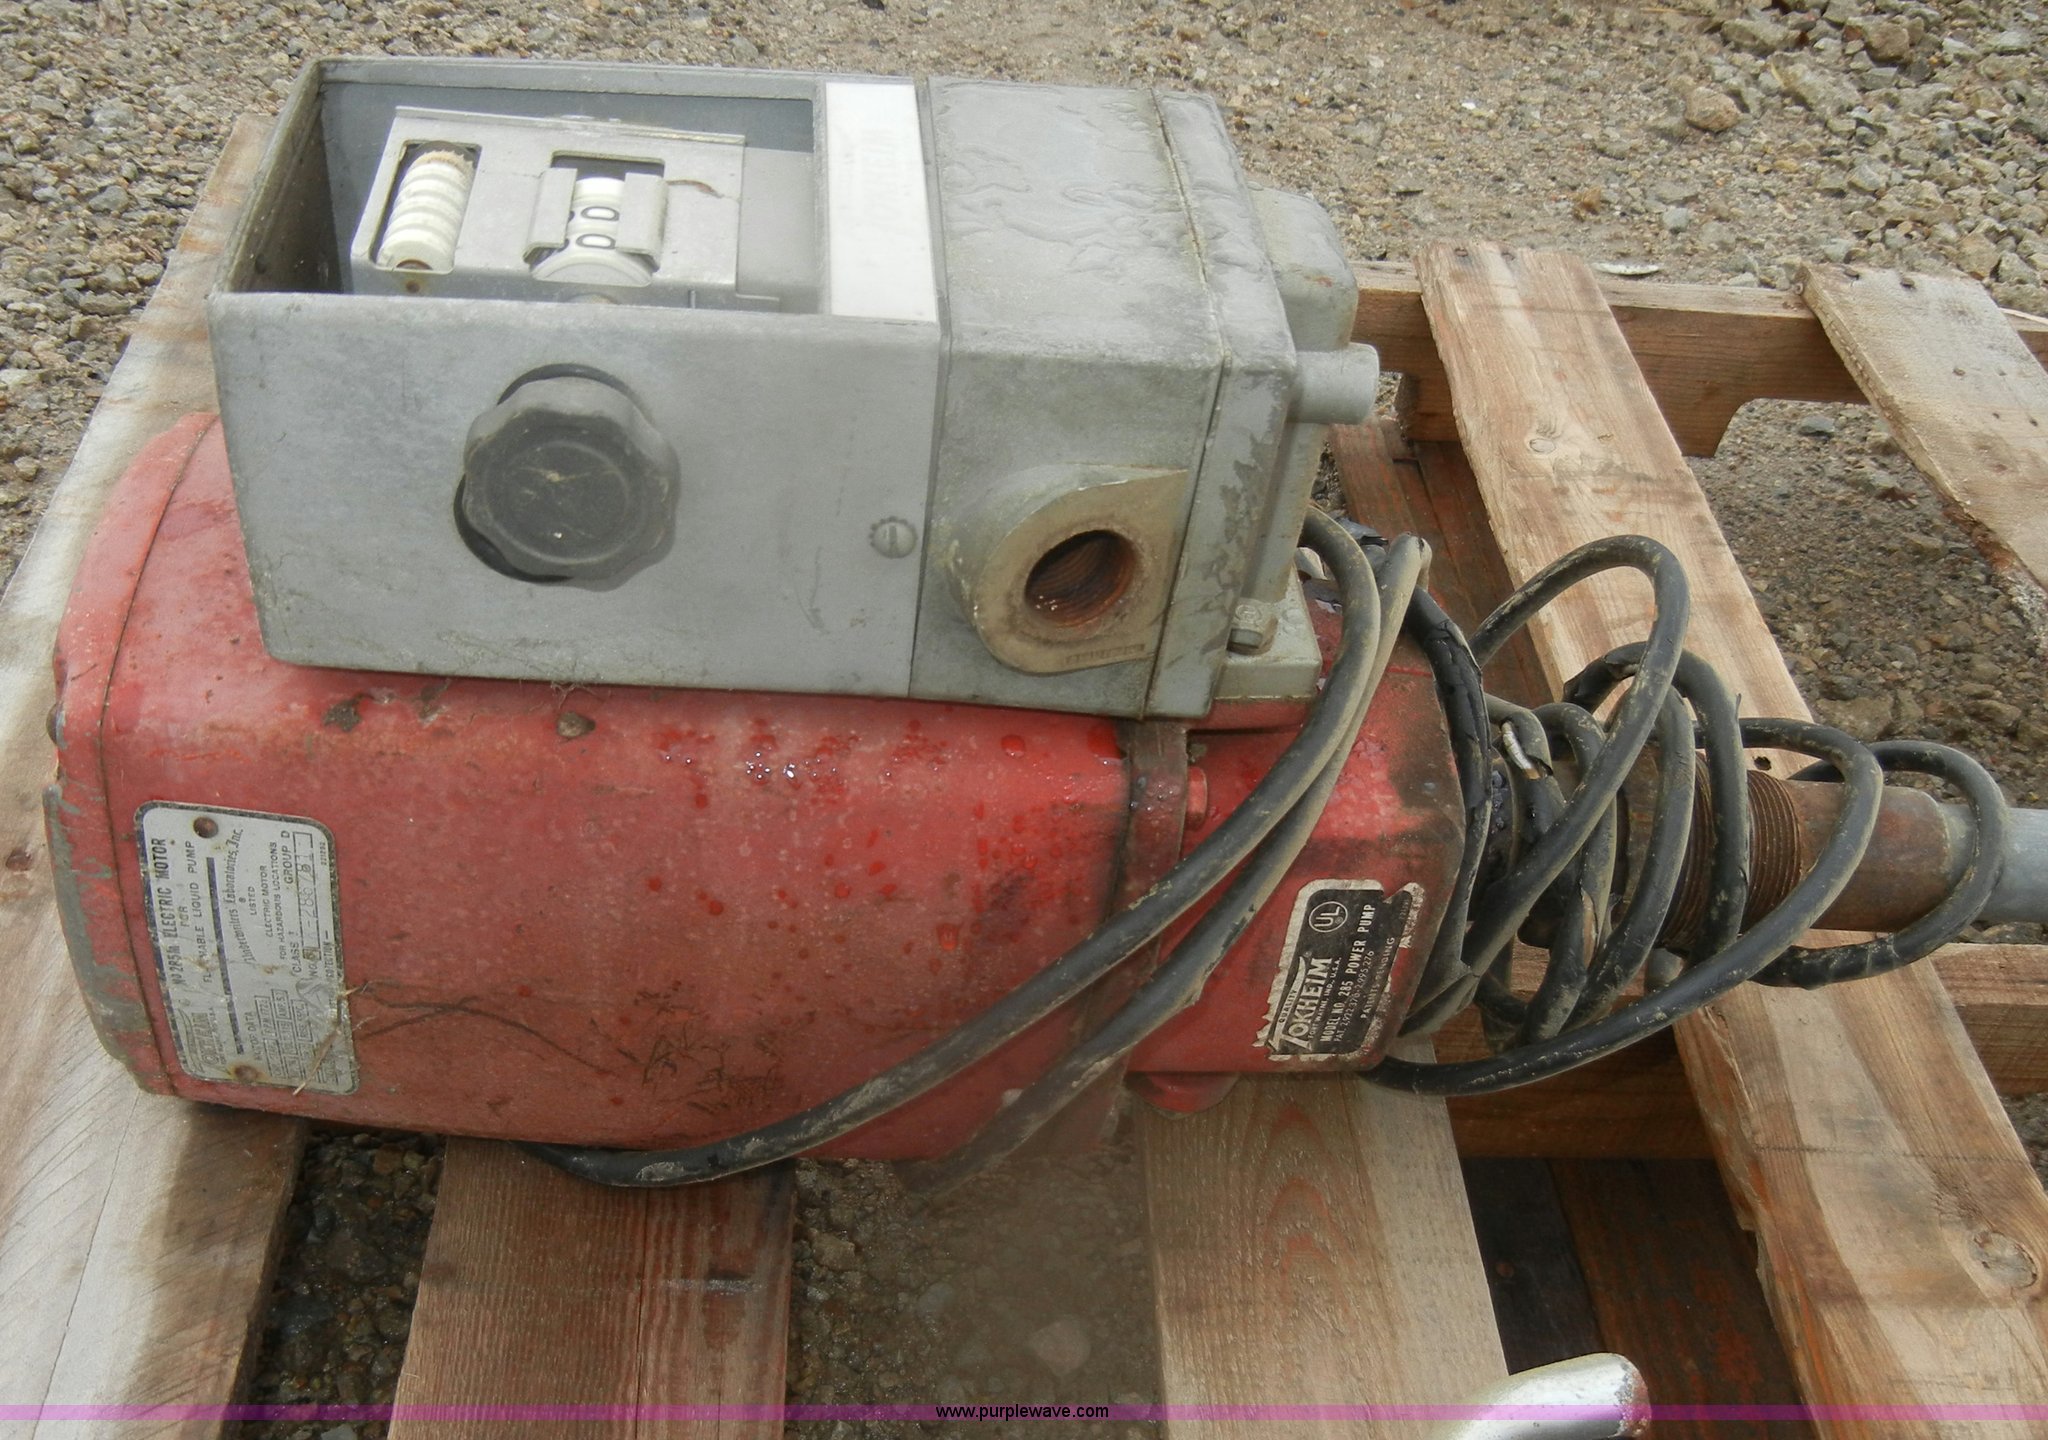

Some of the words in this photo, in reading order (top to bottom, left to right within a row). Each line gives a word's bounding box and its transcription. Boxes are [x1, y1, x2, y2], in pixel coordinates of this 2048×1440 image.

[280, 830, 291, 839] D
[151, 838, 170, 880] MOTOR
[185, 840, 198, 874] PUMP
[269, 841, 281, 891] LOCATIONS
[282, 845, 294, 885] GROUP
[259, 865, 270, 897] MOTOR
[157, 887, 178, 938] ELECTRIC
[177, 905, 190, 928] FOR
[189, 881, 203, 918] LIQUID
[248, 886, 258, 916] LISTED
[261, 897, 274, 938] ELECTRIC
[272, 891, 286, 943] HAZARDOUS
[1357, 904, 1377, 934] PUMP
[289, 941, 302, 974] CLASS
[1345, 940, 1368, 975] POWER
[1338, 980, 1354, 999] 285
[1360, 983, 1381, 1020] PATENTS
[1375, 937, 1396, 983] PENDING
[1267, 957, 1333, 1051] TOKHEIM
[1278, 990, 1298, 1024] QUALITY
[1308, 1022, 1319, 1039] FORT
[1330, 957, 1342, 979] U.S.A.
[1335, 1001, 1348, 1018] NO.
[244, 1011, 256, 1032] DATA
[1319, 1019, 1341, 1043] MODEL
[1333, 1025, 1345, 1043] PAT.
